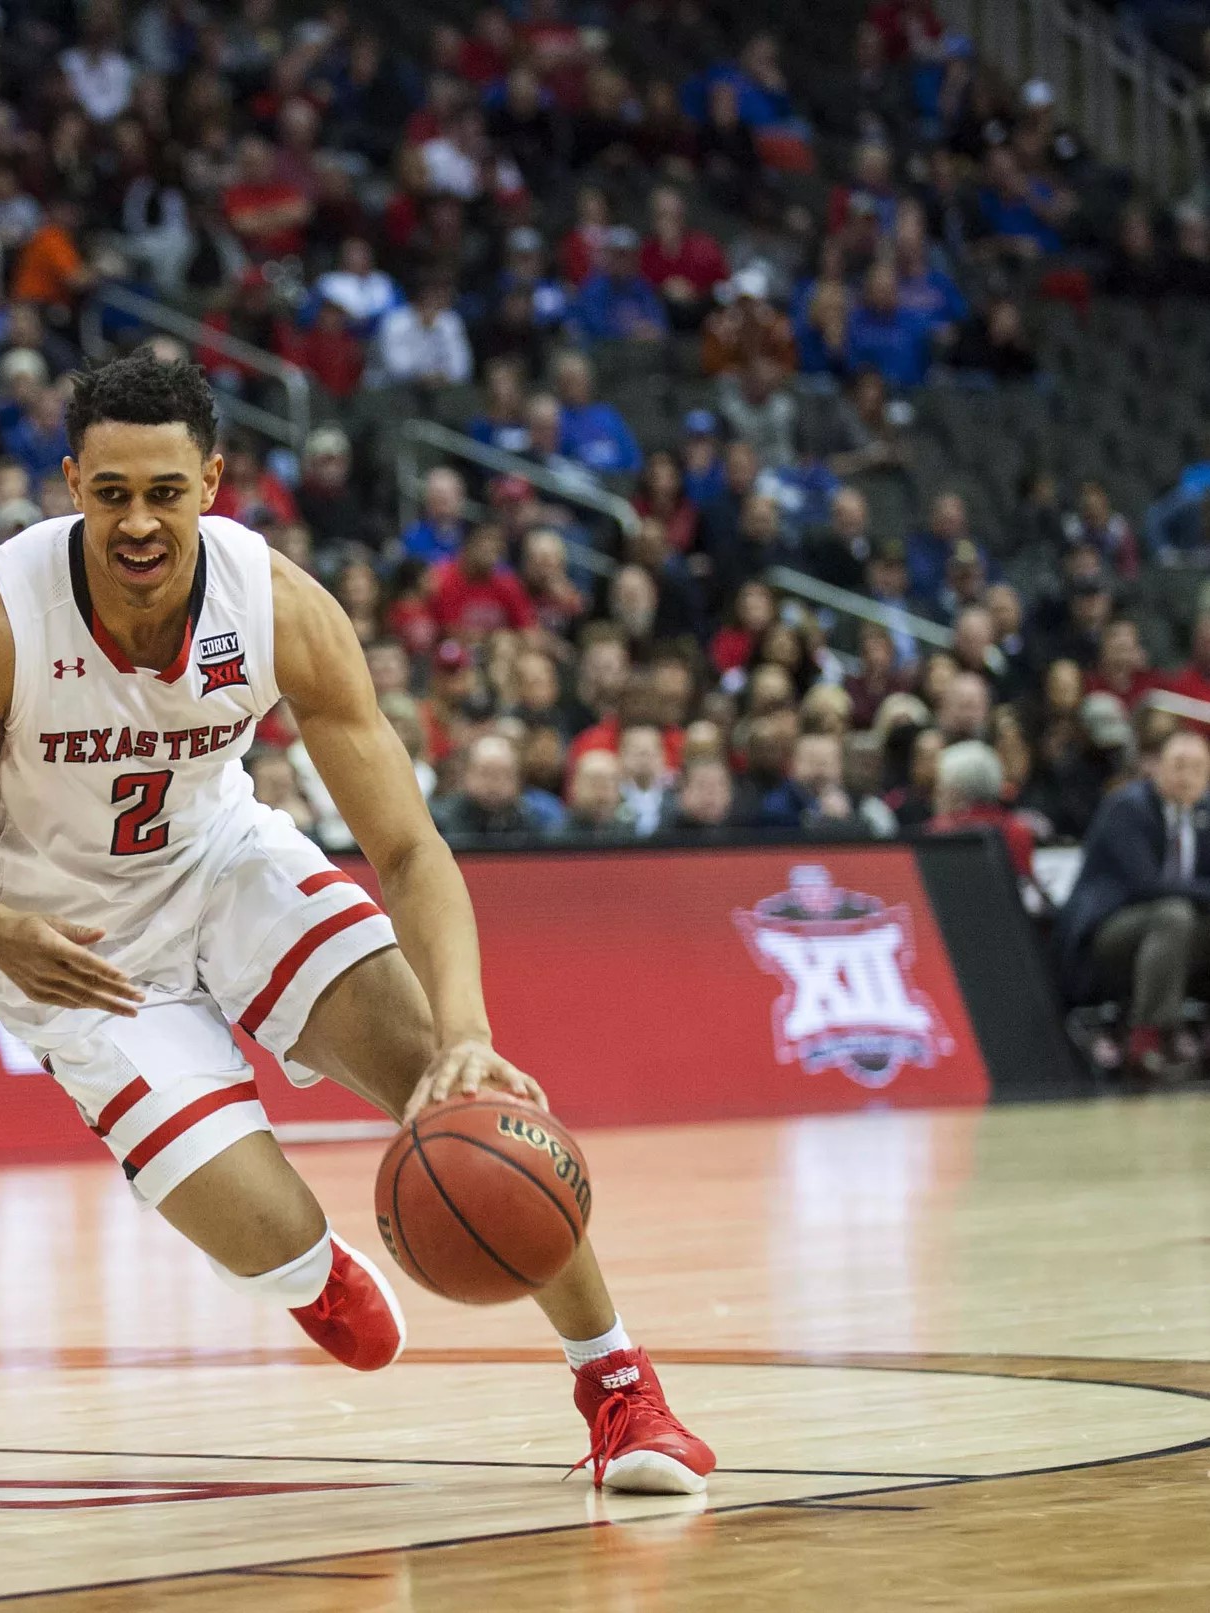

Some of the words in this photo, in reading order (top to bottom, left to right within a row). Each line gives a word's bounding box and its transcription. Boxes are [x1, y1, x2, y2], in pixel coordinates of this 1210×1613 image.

[200, 634, 238, 657] CORKY
[199, 655, 247, 694] XII
[40, 726, 158, 763] TEXAS
[109, 769, 174, 856] 2
[756, 921, 932, 1041] XII
